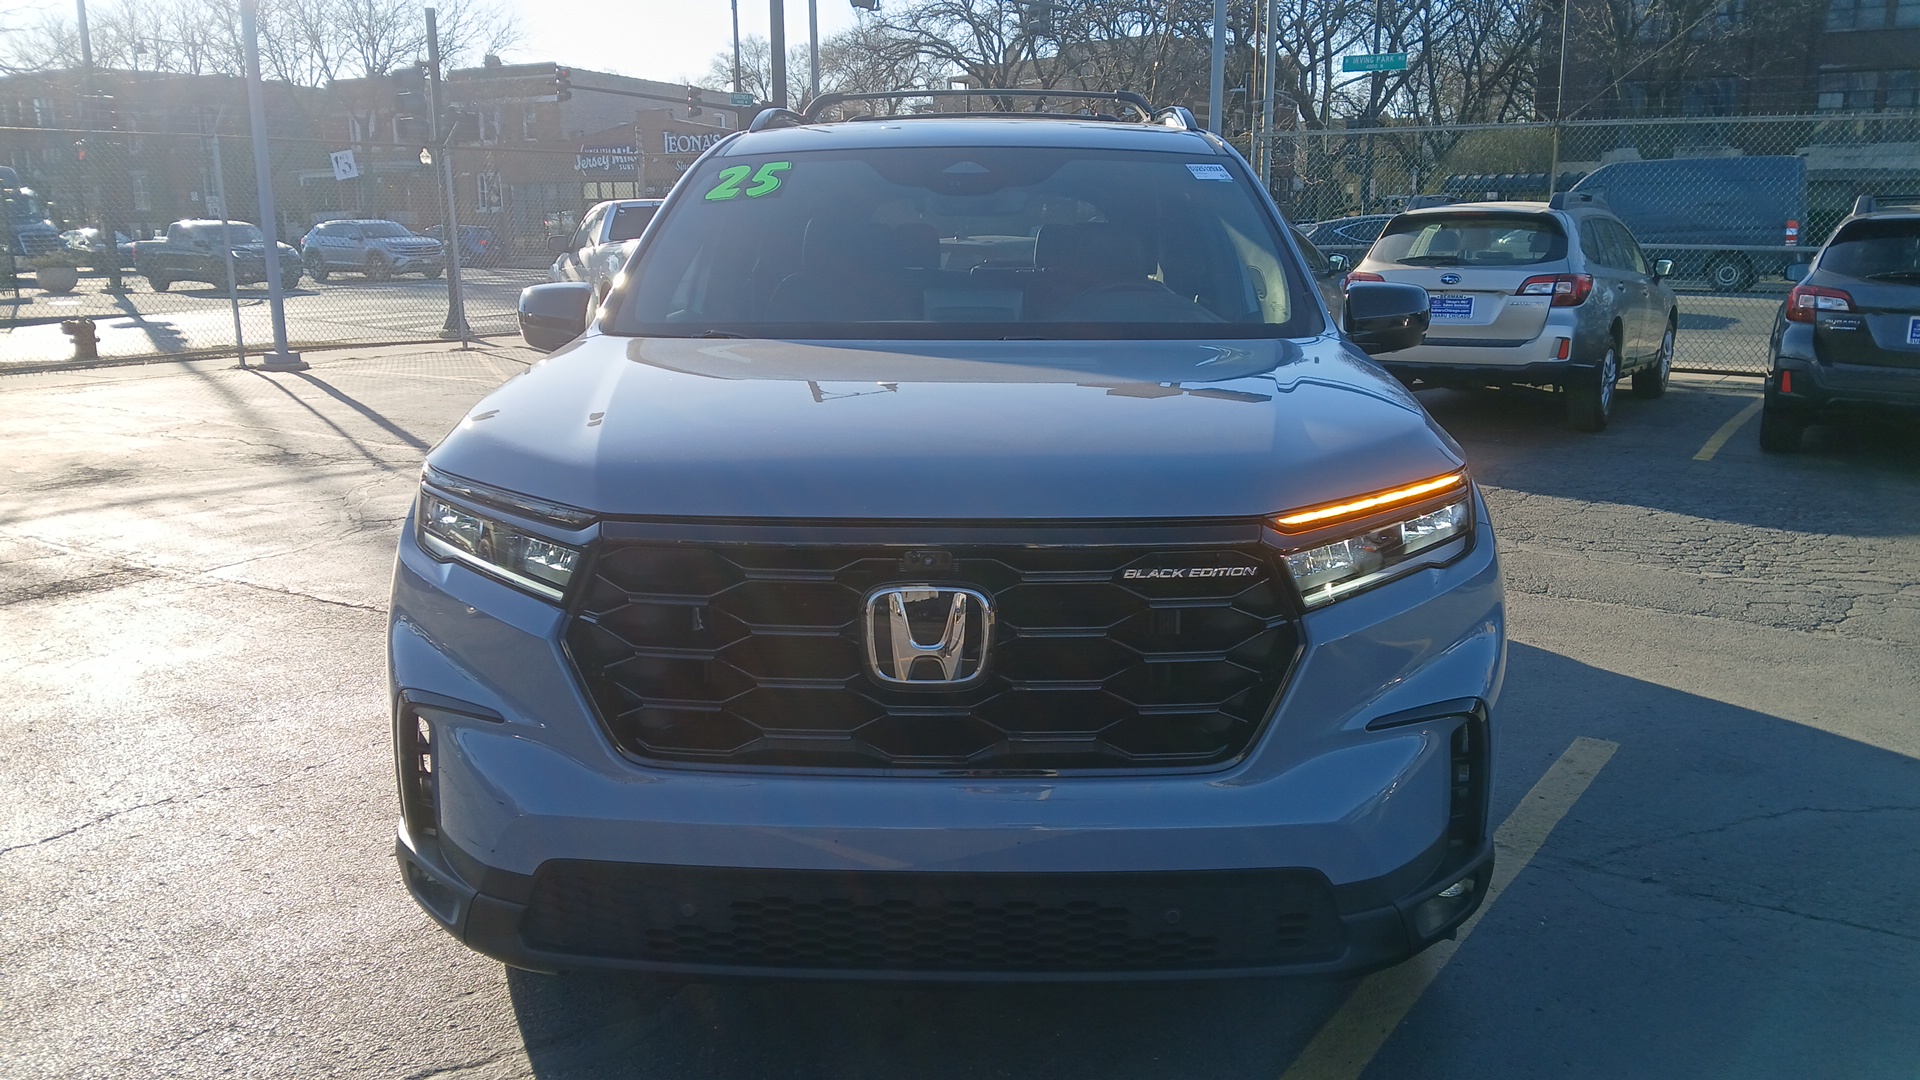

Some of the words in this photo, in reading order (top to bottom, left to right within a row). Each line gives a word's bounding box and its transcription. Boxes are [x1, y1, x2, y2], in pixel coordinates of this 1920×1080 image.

[1353, 56, 1375, 64] IRVING
[1376, 55, 1395, 63] PARK
[663, 132, 720, 154] LEONA'S
[574, 154, 610, 170] Jersey
[705, 162, 792, 201] 25
[1123, 568, 1187, 579] BLACK
[1188, 566, 1257, 578] EDITION
